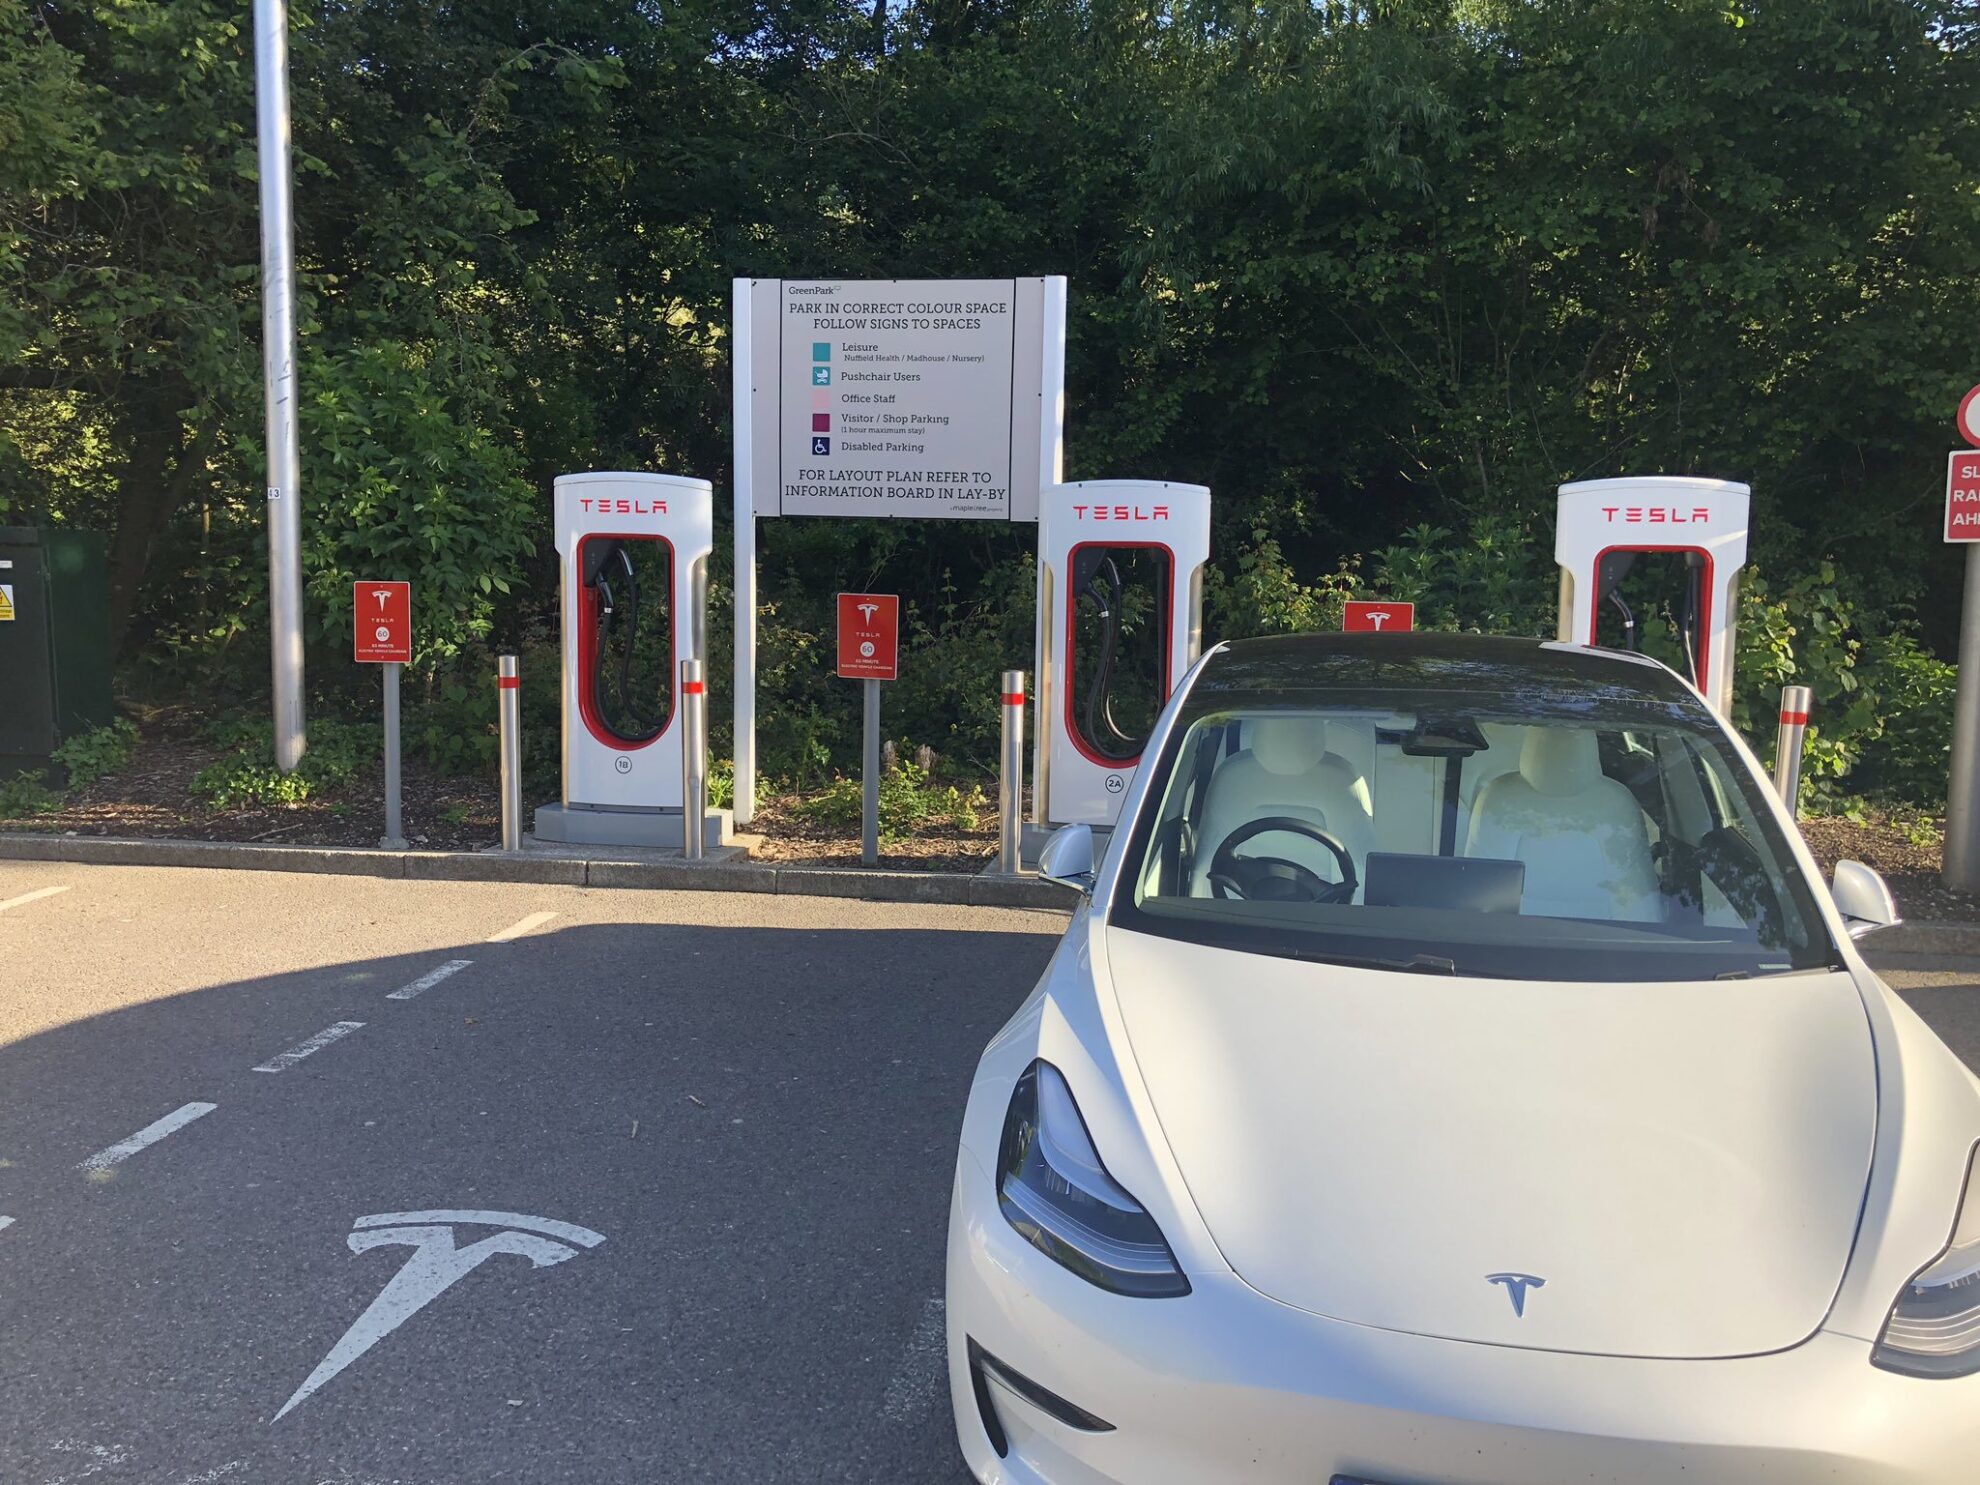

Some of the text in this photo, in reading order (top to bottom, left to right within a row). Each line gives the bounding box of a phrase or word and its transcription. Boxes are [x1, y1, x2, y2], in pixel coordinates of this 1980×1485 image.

[790, 302, 1006, 314] PARK IN CORRECT COLOUR SPACE
[814, 318, 980, 329] FOLLOW SIGNS TO SPACES
[842, 343, 878, 352] Leisure
[841, 372, 921, 381] Pushchair Users
[842, 394, 896, 403] Office Staff
[842, 414, 874, 423] Visitor
[883, 414, 908, 425] Shop
[911, 415, 949, 425] Parking
[842, 442, 924, 453] Disabled Parking
[799, 470, 992, 483] FOR LAYOUT PLAN REFER TO
[785, 485, 1006, 500] INFORMATION BOARD IN LAY-BY
[580, 499, 667, 514] TESLA
[1073, 506, 1168, 520] TESLA
[1602, 508, 1708, 522] TESLA
